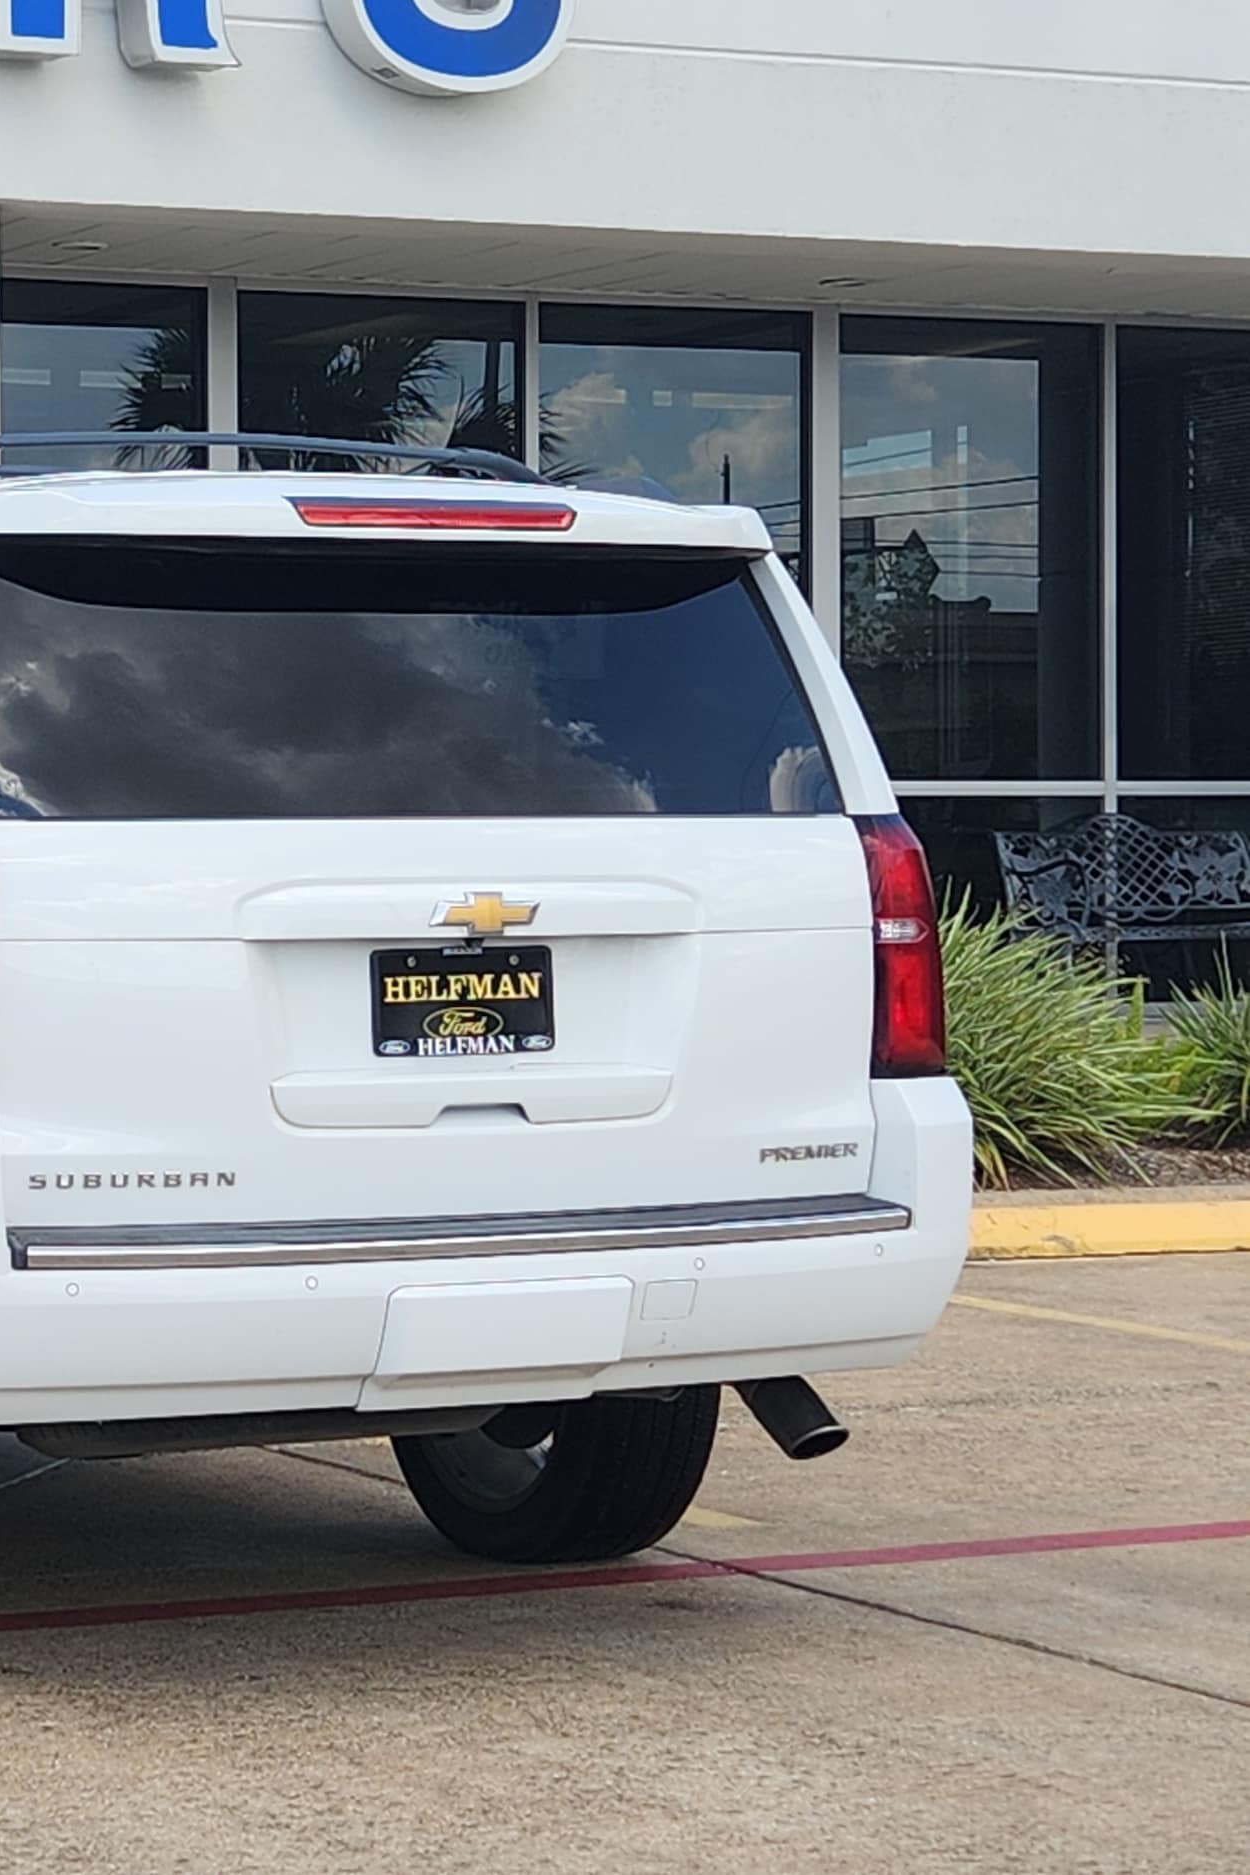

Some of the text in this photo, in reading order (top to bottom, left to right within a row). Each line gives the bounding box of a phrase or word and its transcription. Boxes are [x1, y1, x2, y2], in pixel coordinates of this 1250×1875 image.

[383, 972, 543, 1003] HELFMAN
[438, 1010, 489, 1036] Ford
[417, 1035, 516, 1056] HELFMAN
[759, 1142, 859, 1164] PREMIER
[28, 1172, 237, 1190] SUBURBAN
